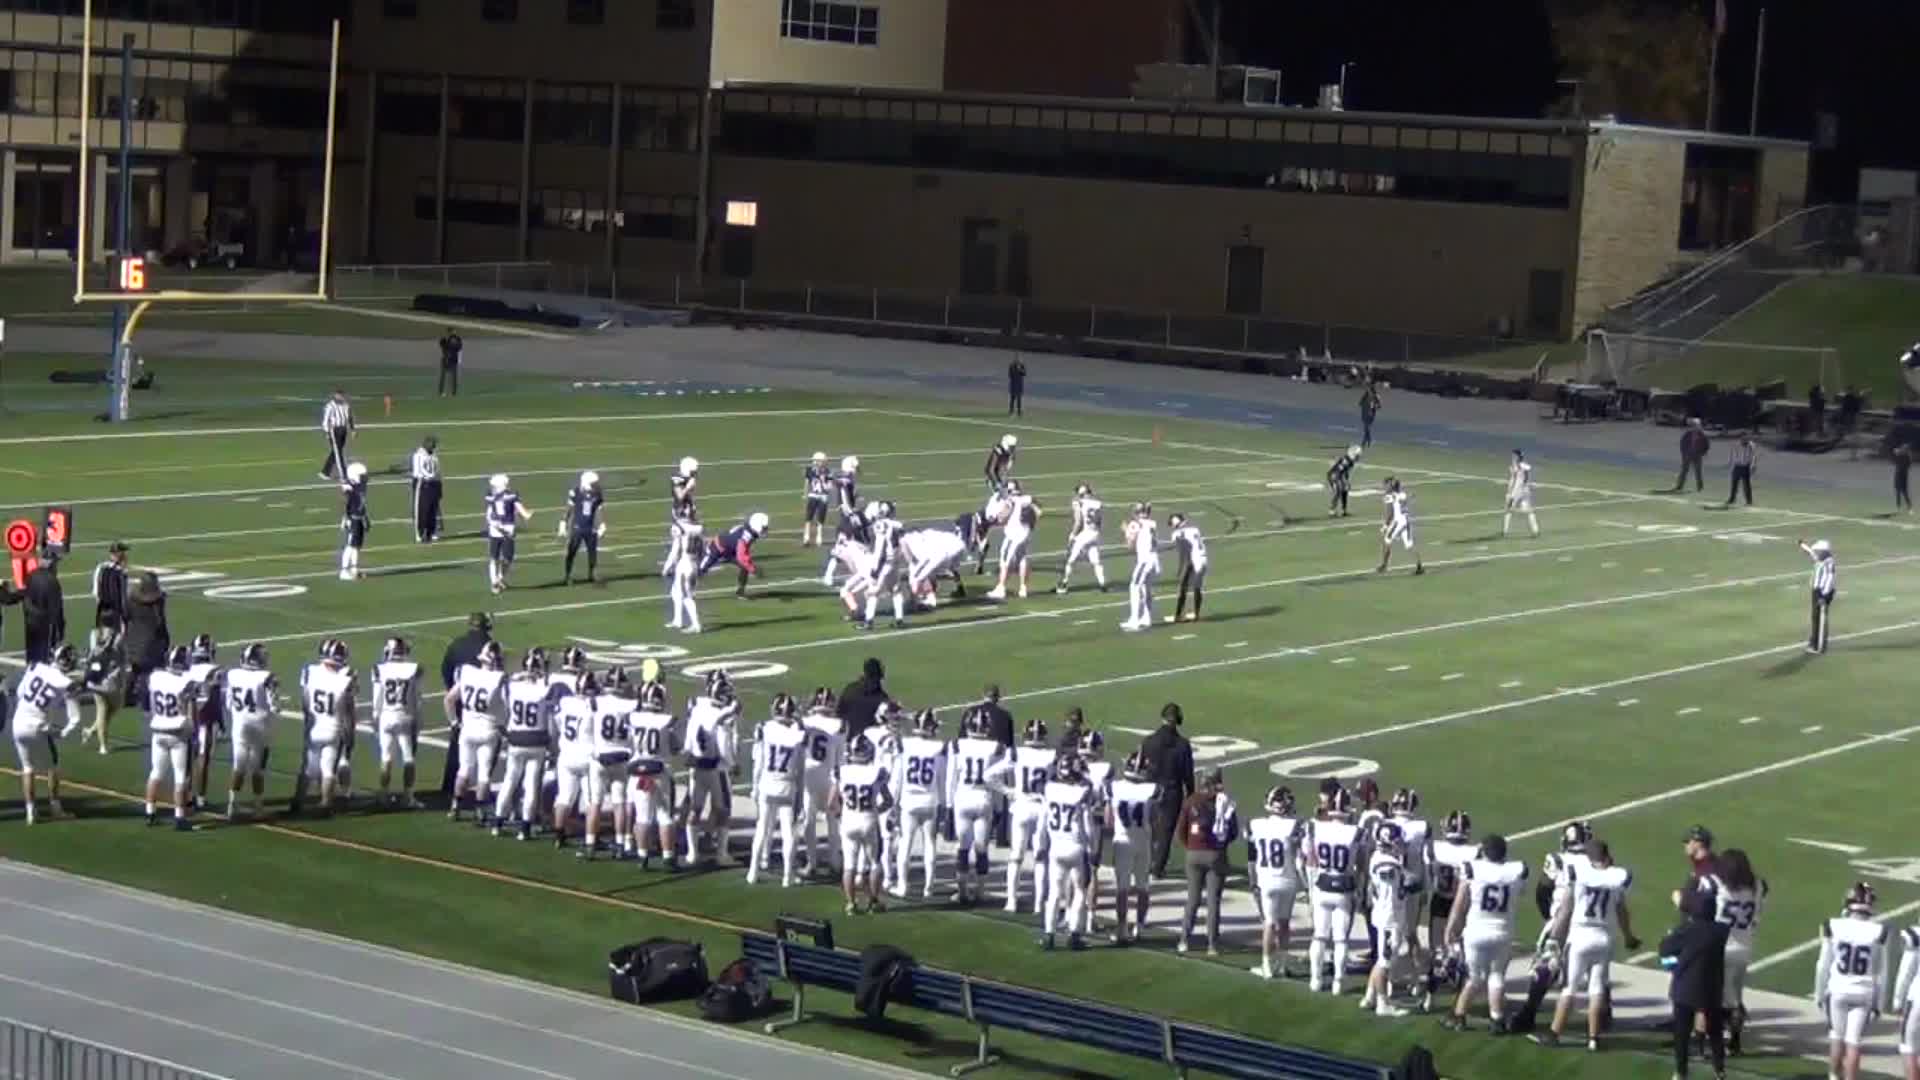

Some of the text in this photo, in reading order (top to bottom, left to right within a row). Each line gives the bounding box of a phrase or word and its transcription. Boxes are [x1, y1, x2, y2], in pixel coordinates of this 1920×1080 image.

[121, 258, 145, 289] 16
[47, 510, 65, 543] 3
[23, 677, 56, 711] 95
[231, 687, 258, 713] 54
[312, 690, 337, 717] 51
[384, 679, 410, 706] 27
[463, 685, 488, 713] 76
[513, 700, 538, 727] 96
[634, 728, 660, 756] 70
[767, 745, 794, 773] 17
[906, 755, 935, 785] 26
[965, 757, 985, 785] 11
[1022, 766, 1047, 794] 12
[843, 784, 874, 812] 32
[1049, 801, 1074, 833] 37
[1258, 838, 1285, 869] 18
[1319, 842, 1350, 873] 90
[1480, 884, 1510, 913] 61
[1583, 885, 1611, 919] 71
[1722, 900, 1756, 930] 53
[1837, 941, 1870, 975] 36
